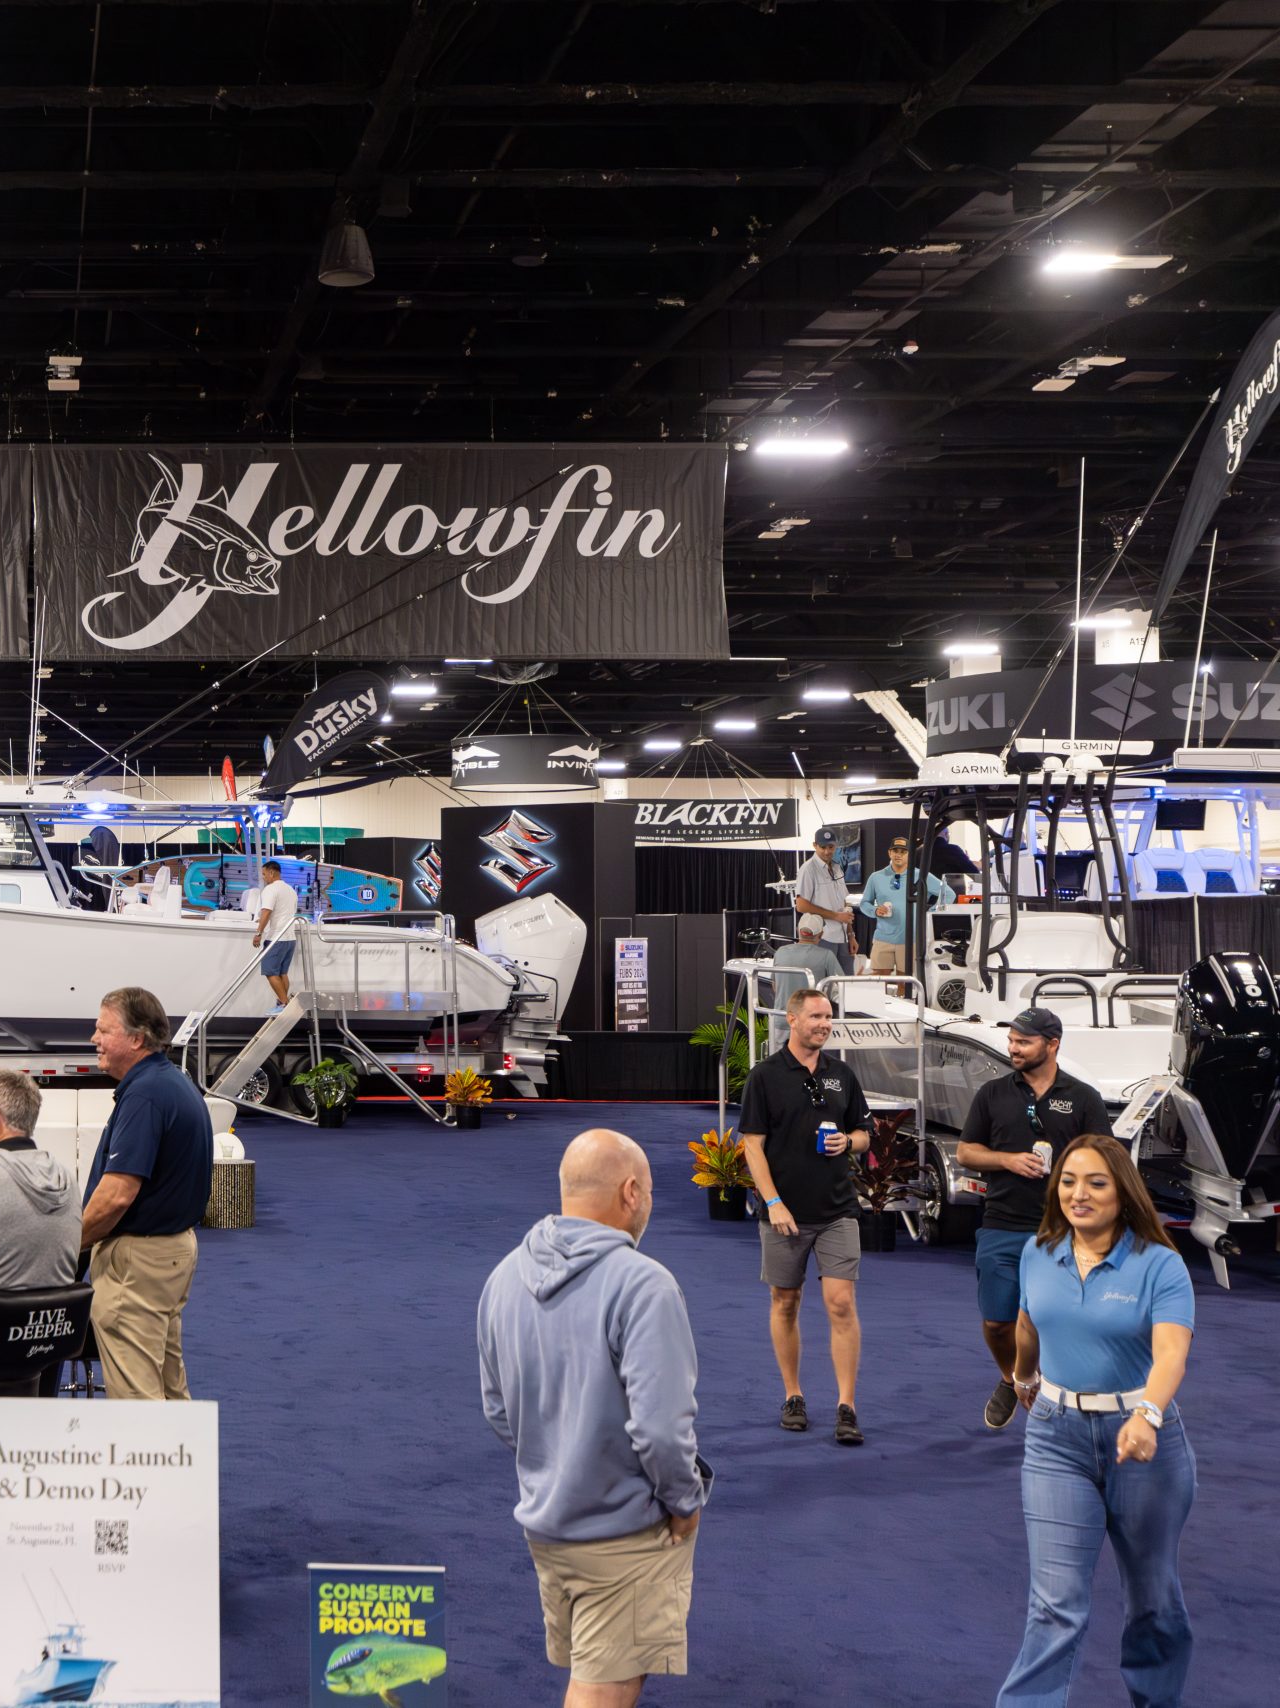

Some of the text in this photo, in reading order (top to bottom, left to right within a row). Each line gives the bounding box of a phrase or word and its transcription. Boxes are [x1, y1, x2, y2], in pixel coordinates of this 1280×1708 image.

[81, 458, 681, 649] Yellowfin
[294, 688, 377, 756] Dusky
[307, 715, 367, 762] FACTORY DIRECT
[1062, 741, 1113, 750] GARMIN
[547, 760, 597, 769] INVINC
[951, 765, 999, 775] GARMIN
[635, 801, 783, 825] BLACKFIN
[27, 1308, 67, 1326] LIVE
[8, 1320, 75, 1342] DEEPER.
[109, 1443, 193, 1467] Launch
[25, 1476, 94, 1500] Demo
[101, 1478, 149, 1510] Day
[10, 1521, 74, 1533] November 23rd
[98, 1563, 126, 1573] RSVP
[319, 1582, 435, 1603] CONSERVE
[319, 1600, 411, 1619] SUSTAIN
[319, 1617, 427, 1637] PROMOTE
